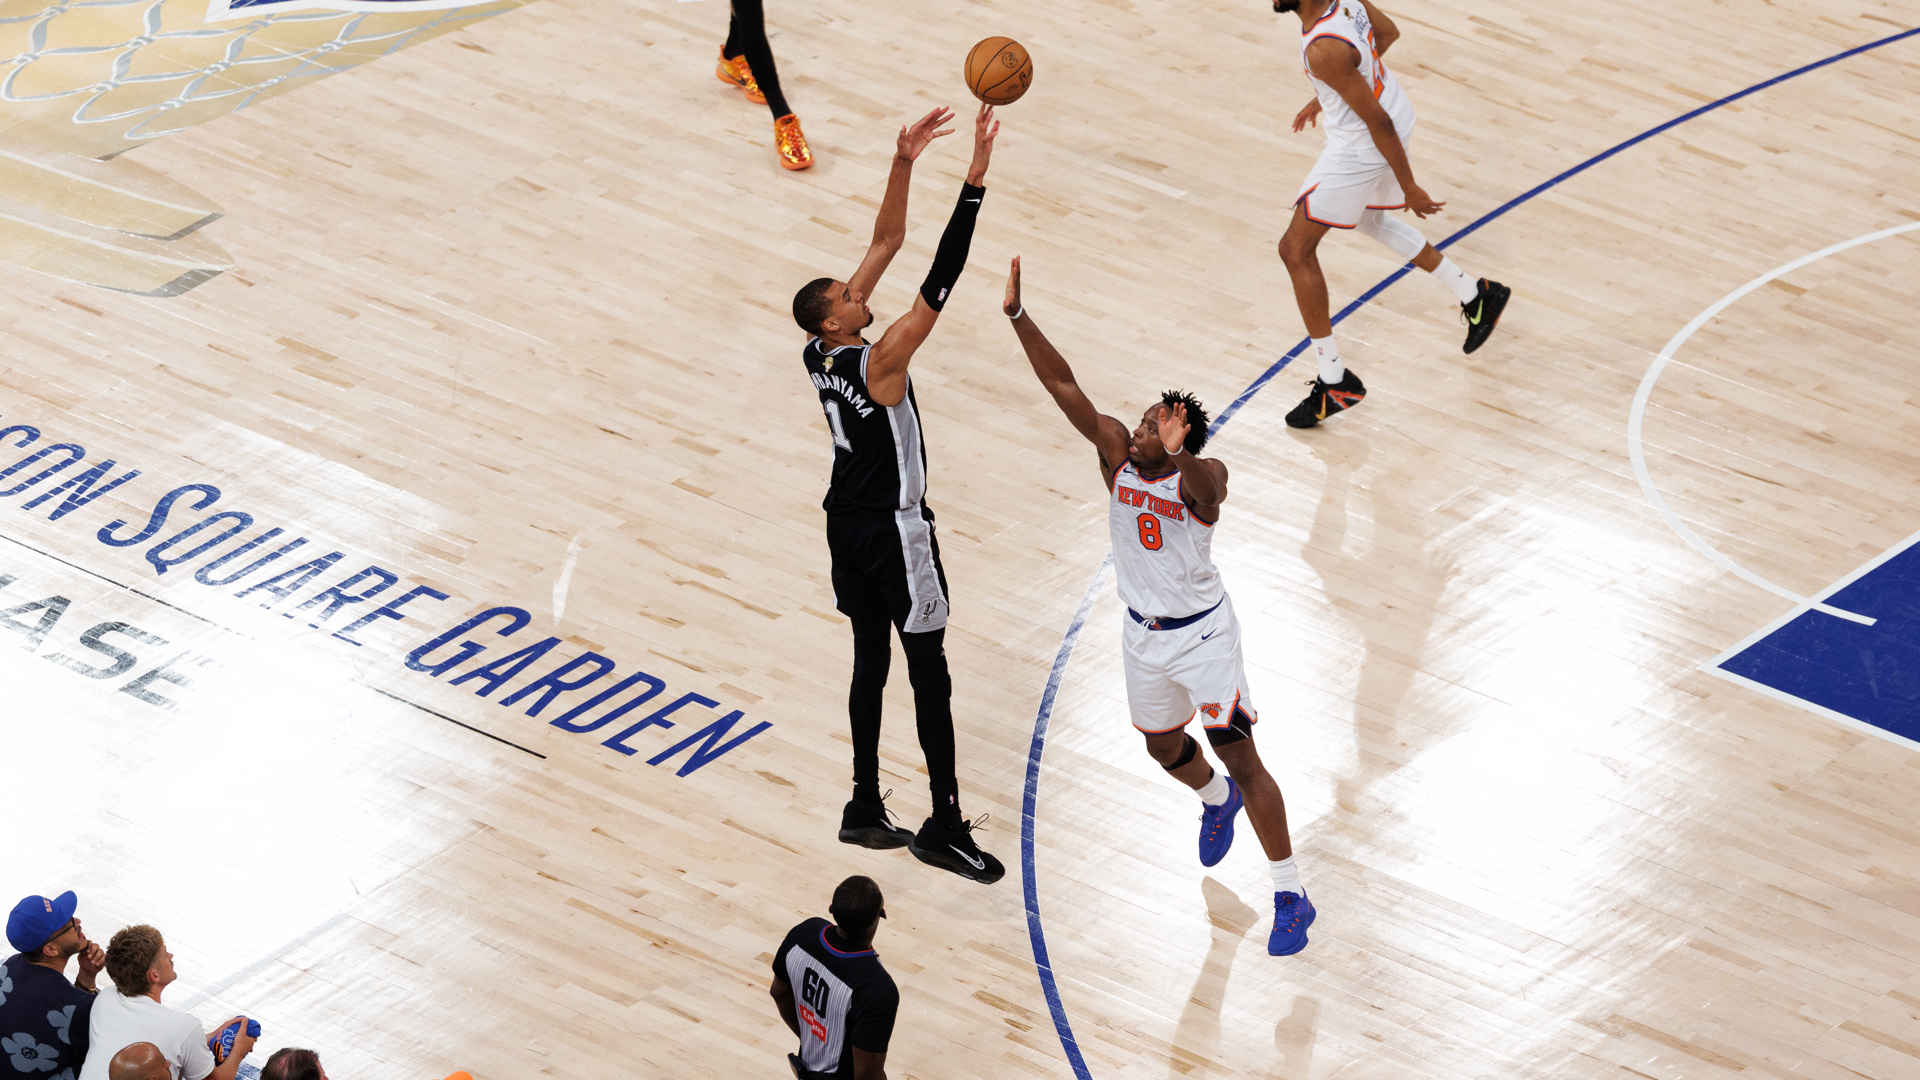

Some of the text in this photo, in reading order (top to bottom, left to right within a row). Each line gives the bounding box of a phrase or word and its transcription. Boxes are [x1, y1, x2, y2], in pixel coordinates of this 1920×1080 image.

[810, 372, 875, 418] MBANYAMA
[824, 399, 853, 453] 1
[1117, 486, 1185, 521] NEW YORK
[1137, 513, 1163, 551] 8
[0, 573, 224, 713] ASE
[97, 483, 450, 646] SQUARE
[404, 606, 774, 777] GARDEN
[802, 967, 830, 1019] 60
[803, 1009, 825, 1038] Emates
